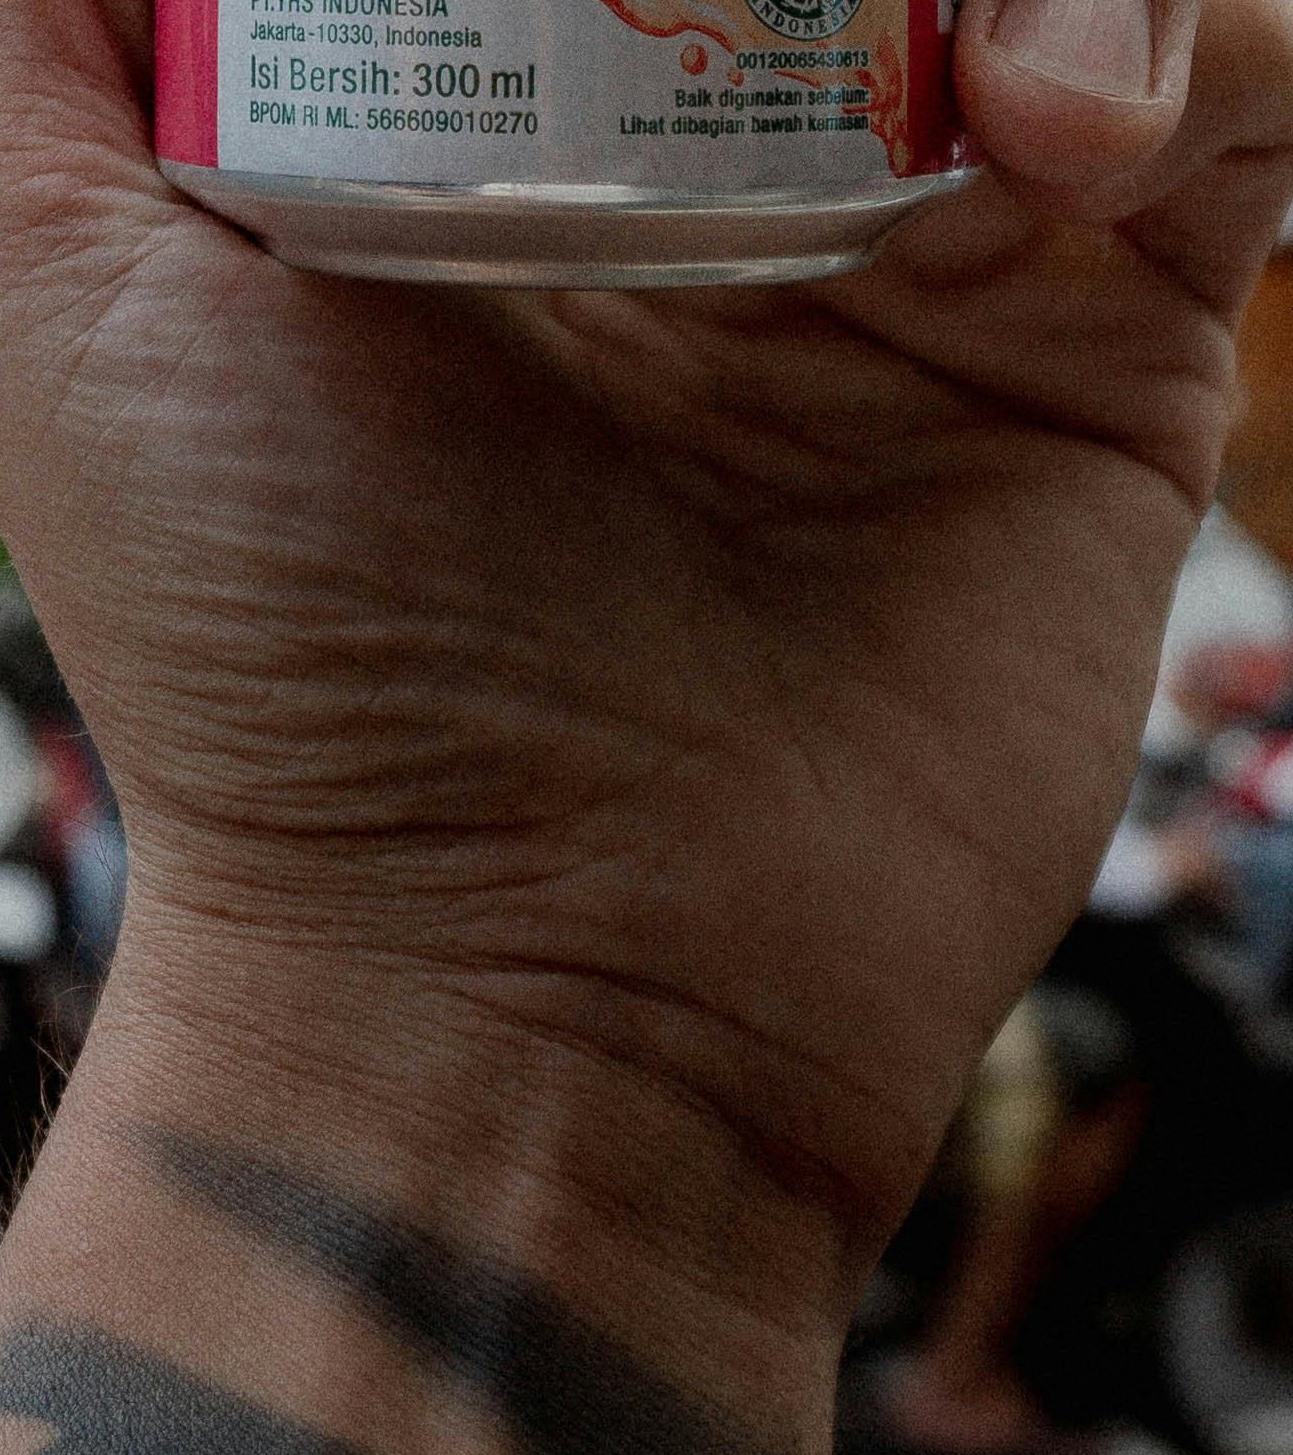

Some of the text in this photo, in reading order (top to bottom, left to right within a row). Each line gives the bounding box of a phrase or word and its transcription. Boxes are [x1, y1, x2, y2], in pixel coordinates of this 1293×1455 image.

[385, 25, 483, 49] Indonesia
[250, 54, 536, 100] Isi Bersih: 300 ml
[674, 86, 870, 111] Baik digunakan sebelum:
[249, 100, 539, 136] BPOM RI ML: 566609010270
[619, 113, 870, 139] Lihat dibagian bawah kemasan
